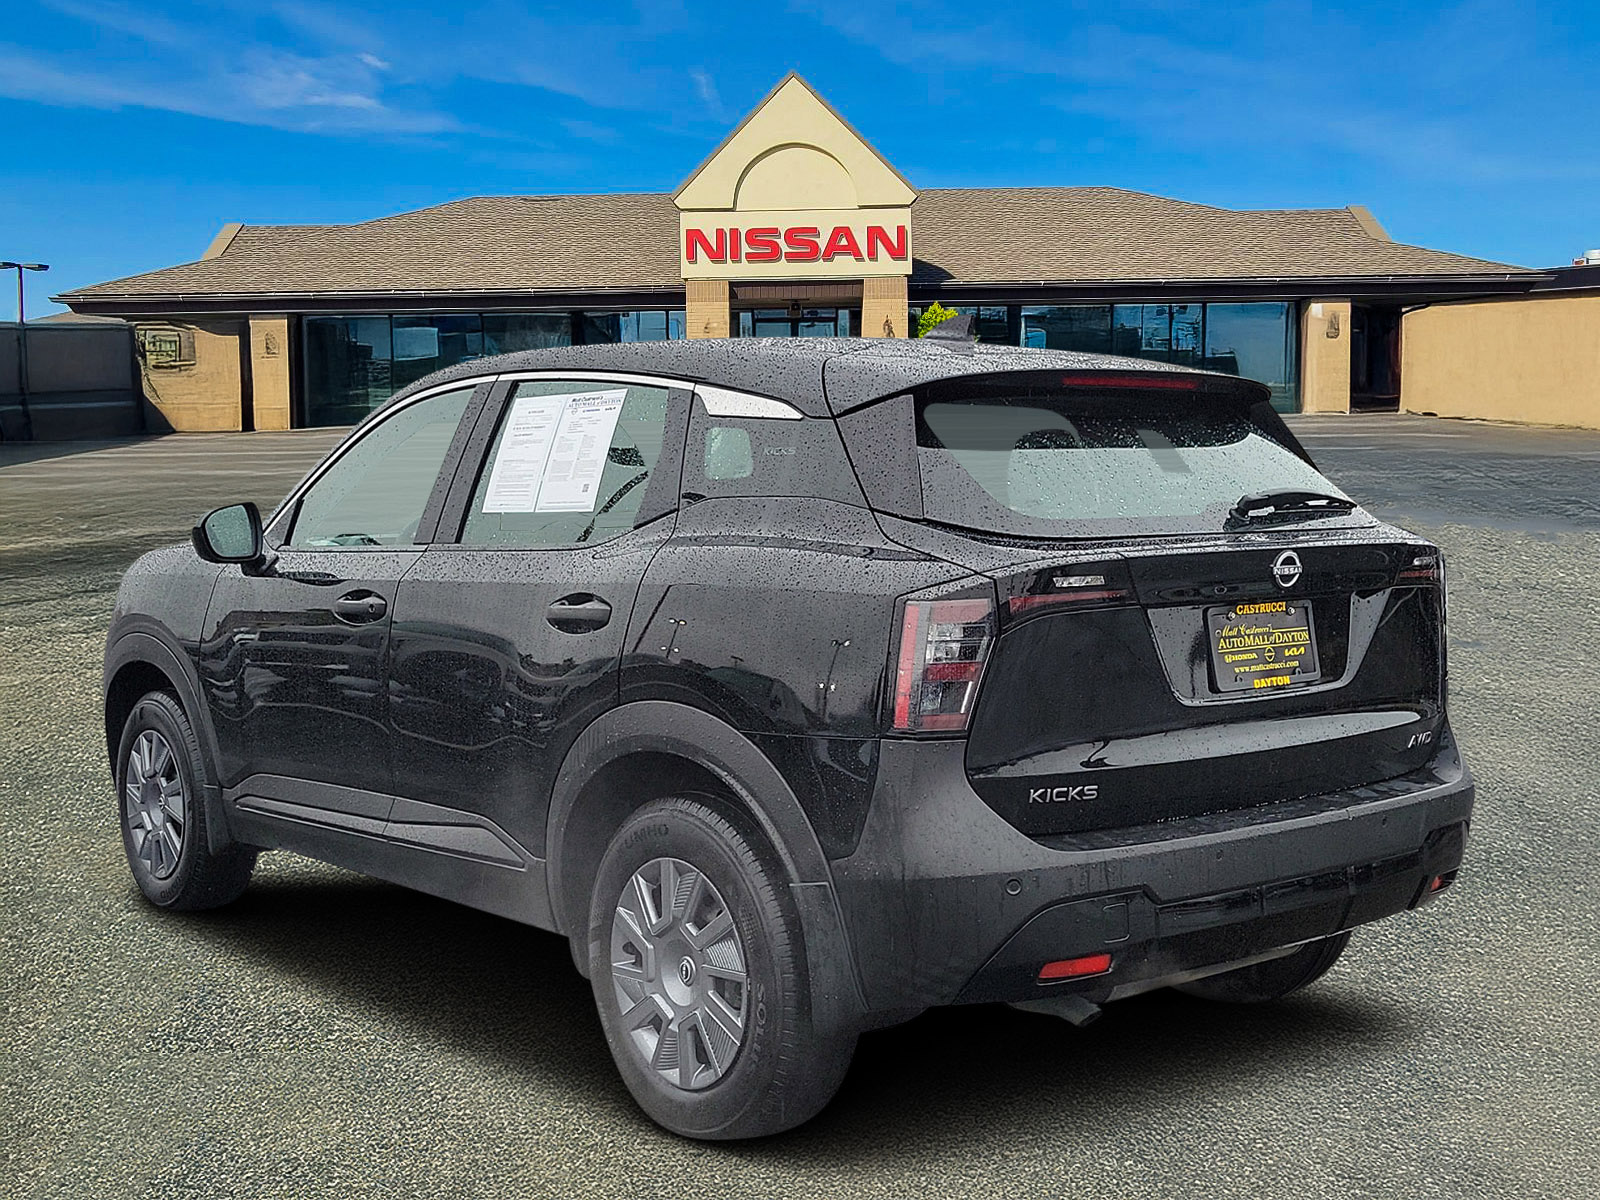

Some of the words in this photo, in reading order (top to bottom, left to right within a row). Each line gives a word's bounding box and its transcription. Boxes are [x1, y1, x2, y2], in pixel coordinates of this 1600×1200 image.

[685, 225, 908, 264] NISSAN
[762, 446, 797, 456] KICKS
[1273, 567, 1303, 576] NISSAN
[1236, 601, 1287, 615] CASTRUCCI
[1275, 631, 1310, 644] DAYTON
[1232, 653, 1259, 661] HONDA
[1284, 646, 1306, 657] KIA
[1253, 675, 1291, 689] DAYTON
[1028, 785, 1099, 804] KICKS
